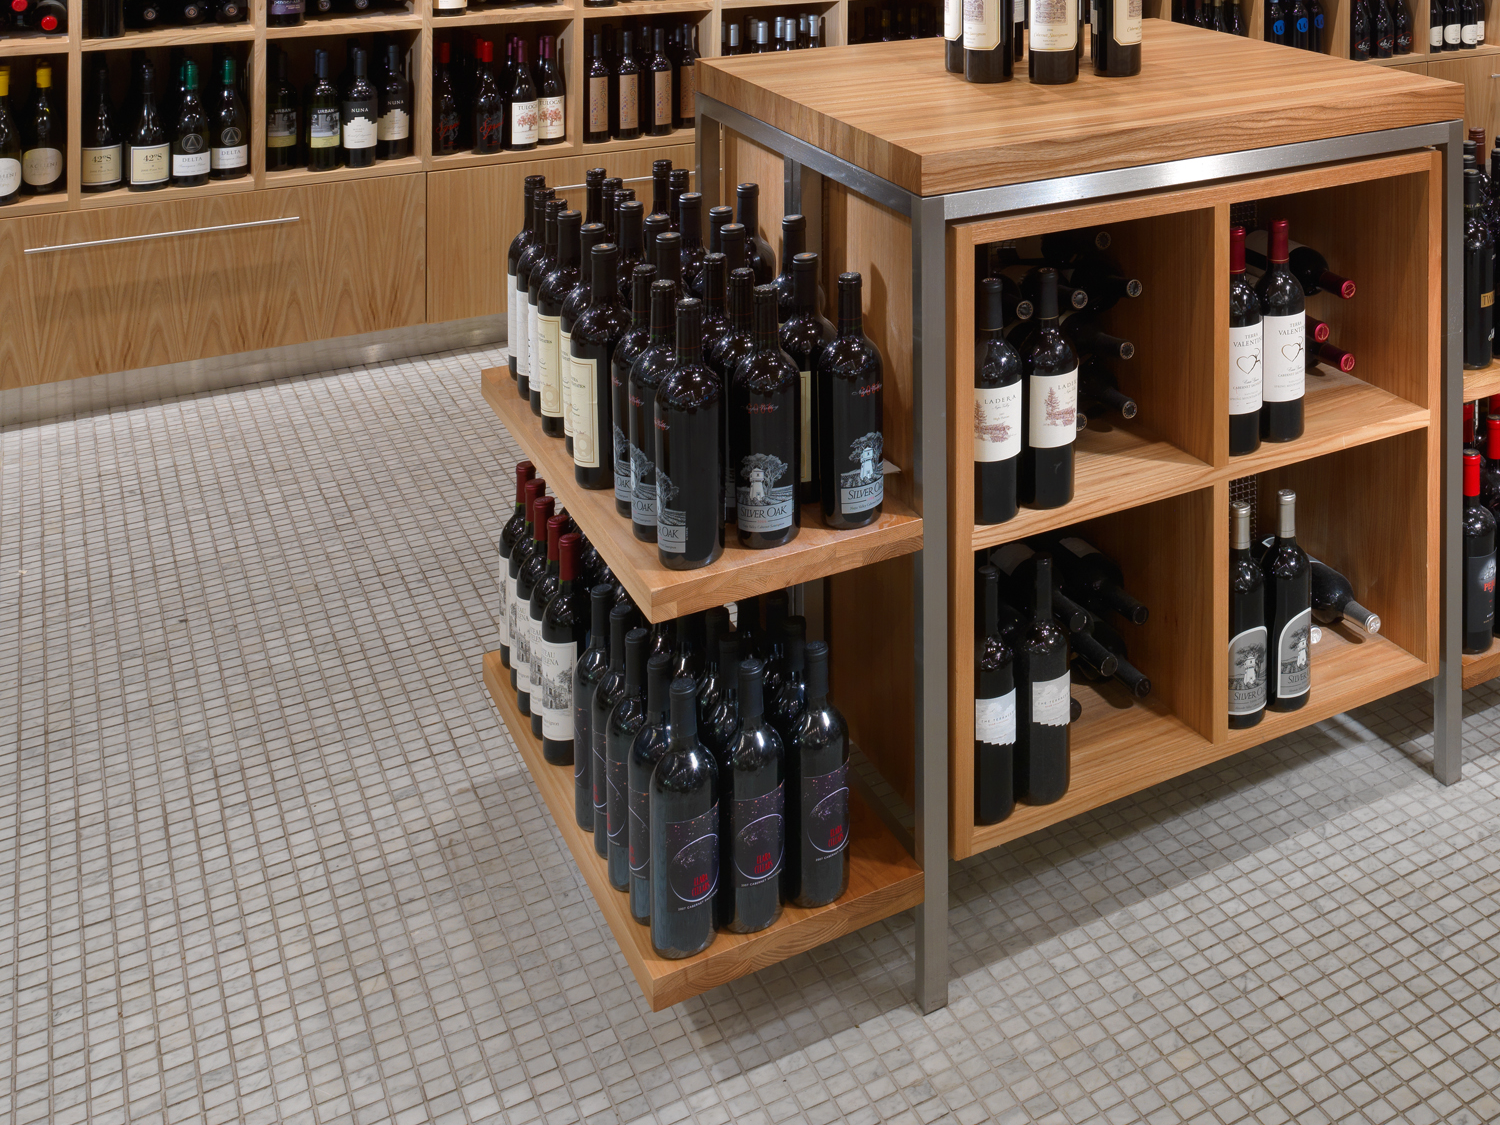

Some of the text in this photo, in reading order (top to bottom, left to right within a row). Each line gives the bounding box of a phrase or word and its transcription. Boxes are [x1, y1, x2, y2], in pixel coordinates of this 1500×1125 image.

[985, 394, 1016, 404] LADERA
[616, 477, 630, 488] OAK
[848, 490, 873, 500] SILVER
[637, 500, 654, 512] OAK
[741, 505, 787, 518] SILVER OAK
[662, 527, 678, 538] OAK
[1288, 674, 1307, 684] SILVER
[1234, 691, 1256, 701] SILVER
[830, 825, 842, 837] ELARA
[828, 833, 843, 848] CELLARS
[756, 852, 771, 864] ELARA
[754, 860, 774, 874] CELLARS
[693, 873, 708, 886] ELARA
[692, 881, 710, 897] CELLARS
